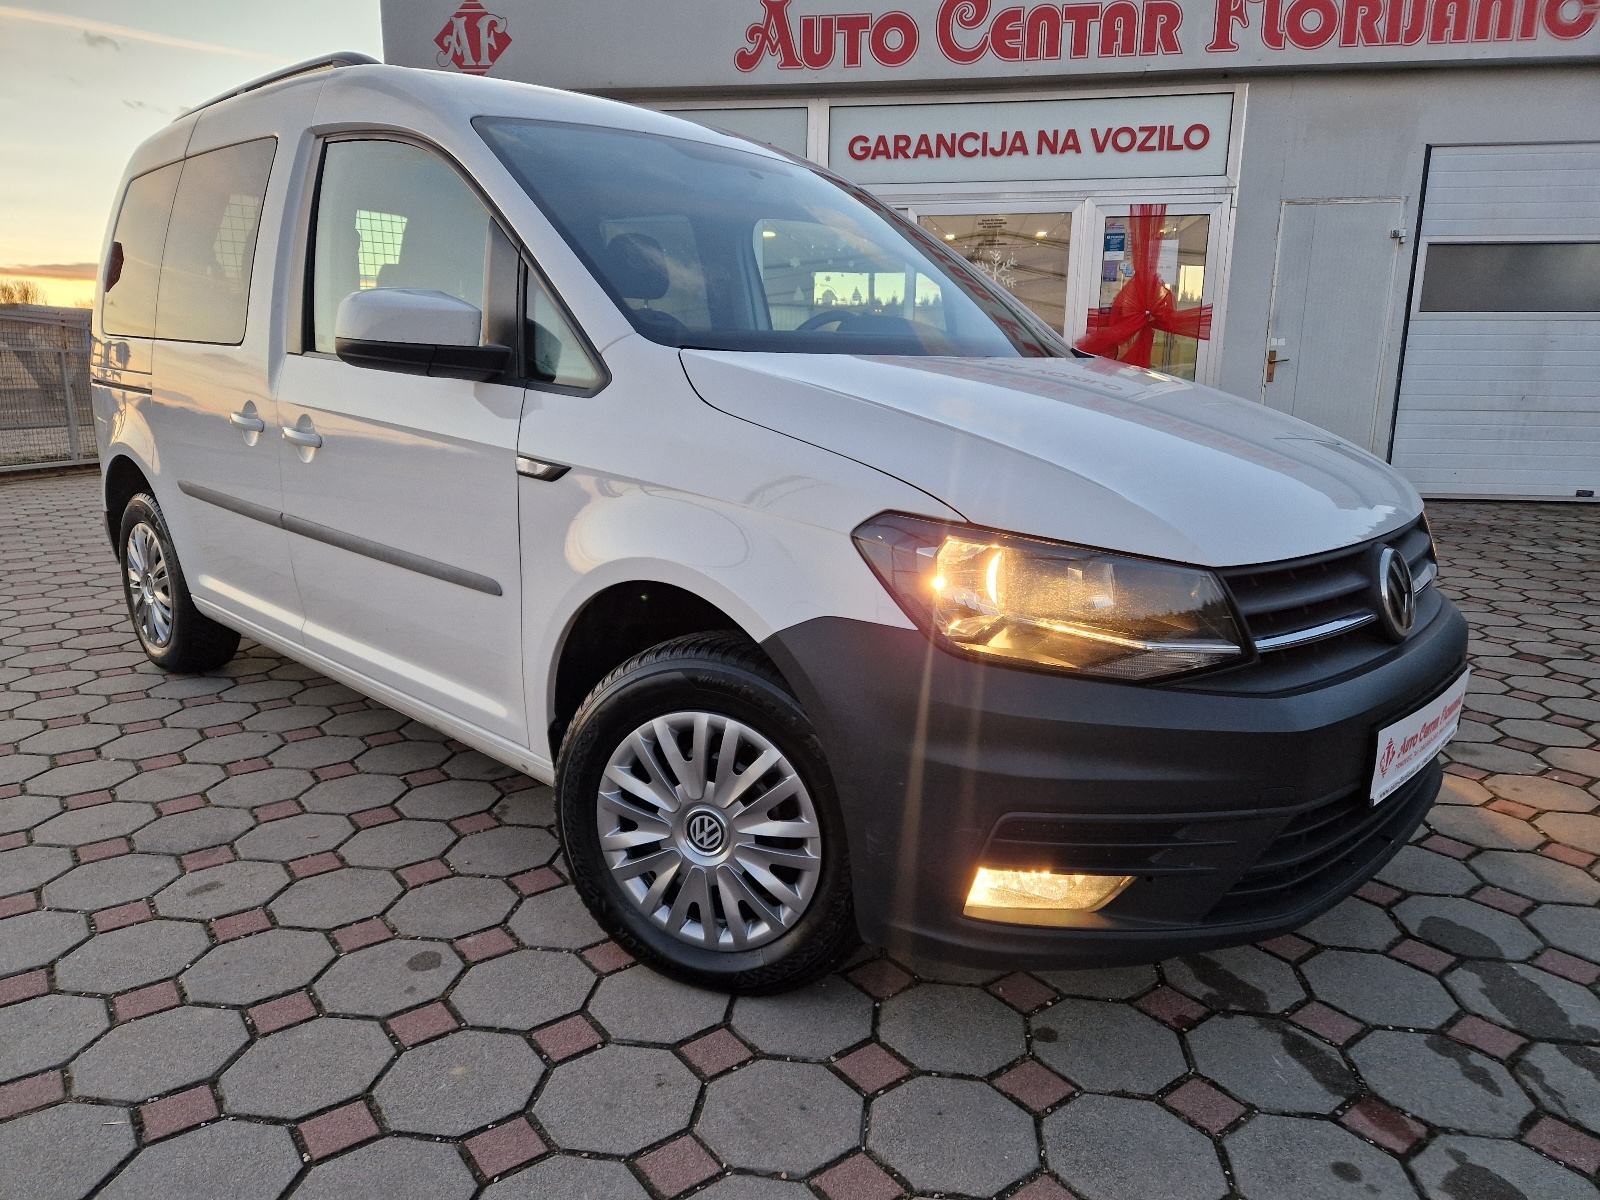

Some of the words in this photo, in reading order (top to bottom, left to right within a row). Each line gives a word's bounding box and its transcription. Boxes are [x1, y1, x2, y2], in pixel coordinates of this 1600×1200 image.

[734, 0, 920, 72] AUTO
[935, 0, 1184, 65] CENTAR
[847, 130, 1029, 161] GARANCIJA
[1036, 128, 1082, 155] NA
[1090, 123, 1210, 153] VOZILO
